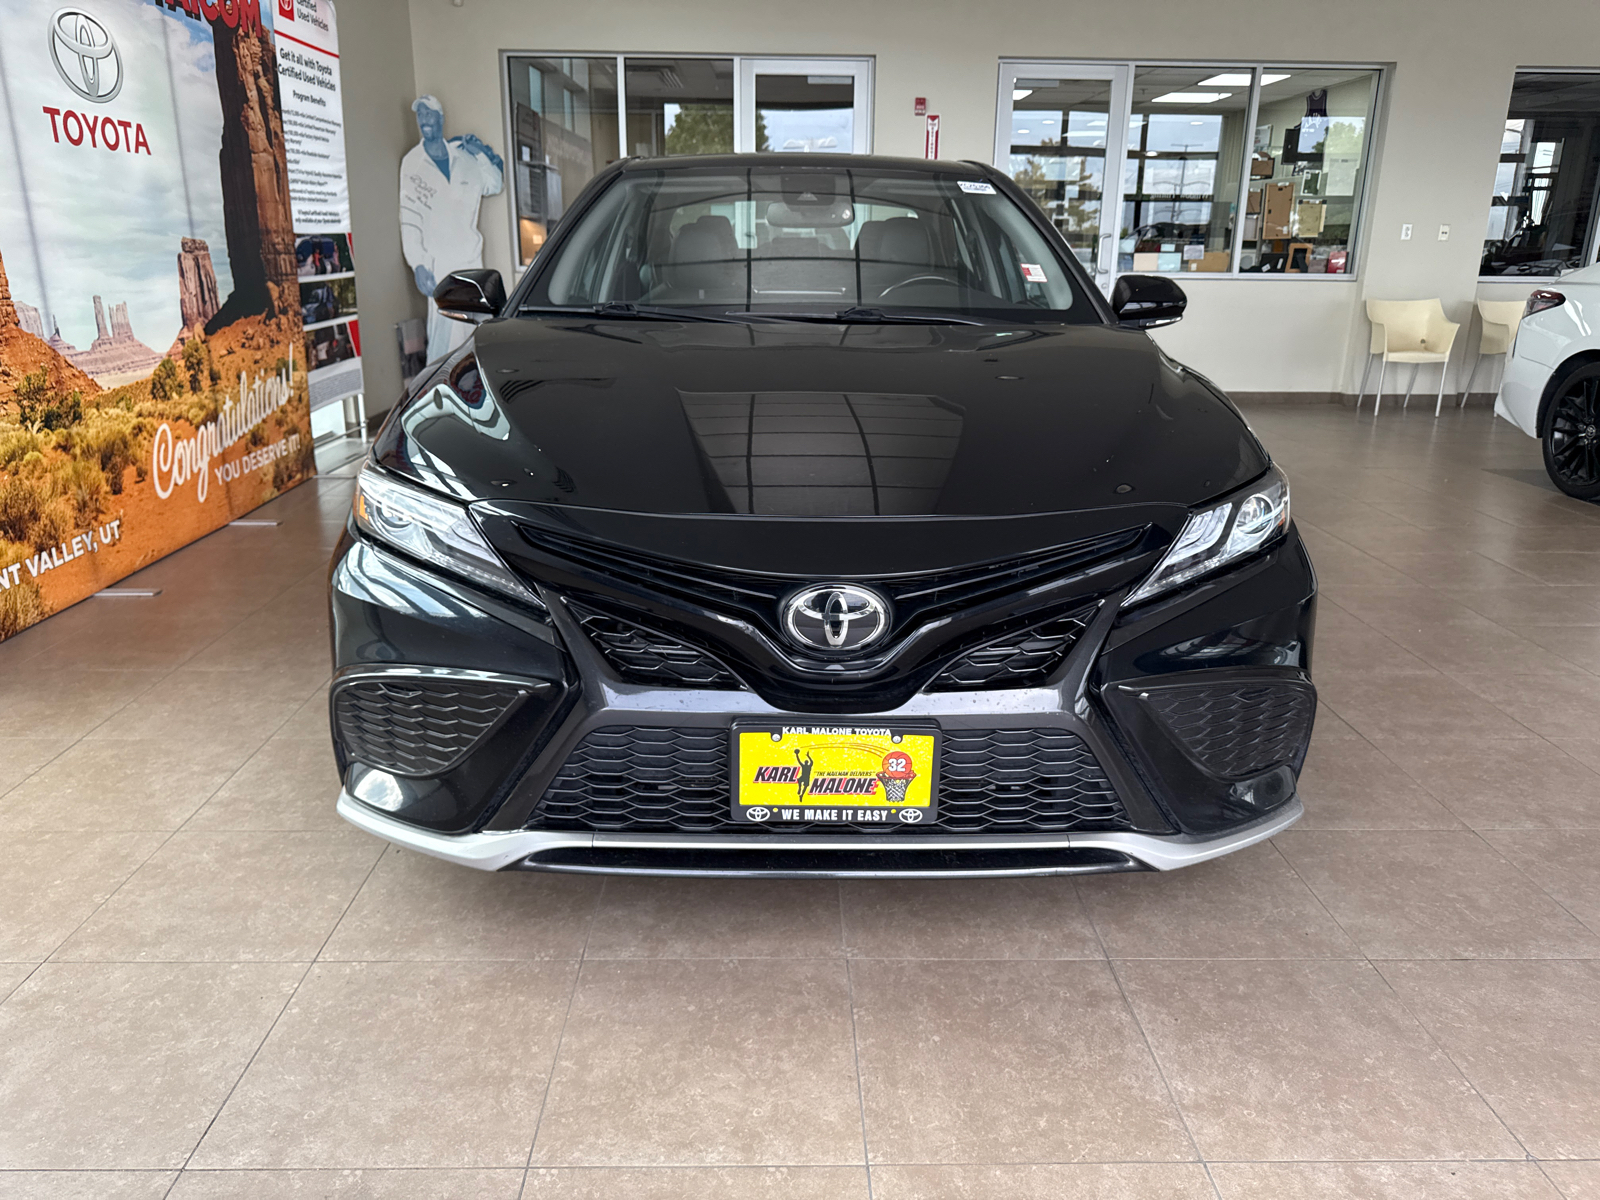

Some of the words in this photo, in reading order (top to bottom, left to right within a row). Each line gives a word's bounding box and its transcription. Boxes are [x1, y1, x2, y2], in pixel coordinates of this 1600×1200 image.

[297, 8, 310, 22] Used
[310, 13, 329, 31] Vehicles
[280, 47, 291, 62] Get
[291, 51, 296, 64] it
[304, 57, 315, 70] with
[315, 60, 332, 76] Toyota
[277, 63, 302, 81] Certified
[302, 71, 316, 85] Used
[316, 76, 336, 92] Vehicles
[292, 90, 311, 103] Program
[310, 95, 326, 107] Benefits
[42, 106, 152, 156] TOYOTA
[152, 342, 295, 504] Congratulations!
[214, 459, 240, 485] YOU
[242, 438, 288, 474] DESERVE
[288, 433, 301, 453] IT!
[25, 530, 98, 578] VALLEY,
[99, 519, 120, 544] UT
[782, 727, 809, 735] KARL
[812, 727, 852, 735] MALONE
[855, 728, 891, 736] TOYOTA
[888, 758, 906, 771] 32
[753, 766, 800, 783] KARL
[808, 777, 878, 795] MALONE
[782, 809, 799, 820] WE
[804, 809, 838, 821] MAKE
[842, 809, 854, 821] IT
[857, 809, 888, 821] EASY
